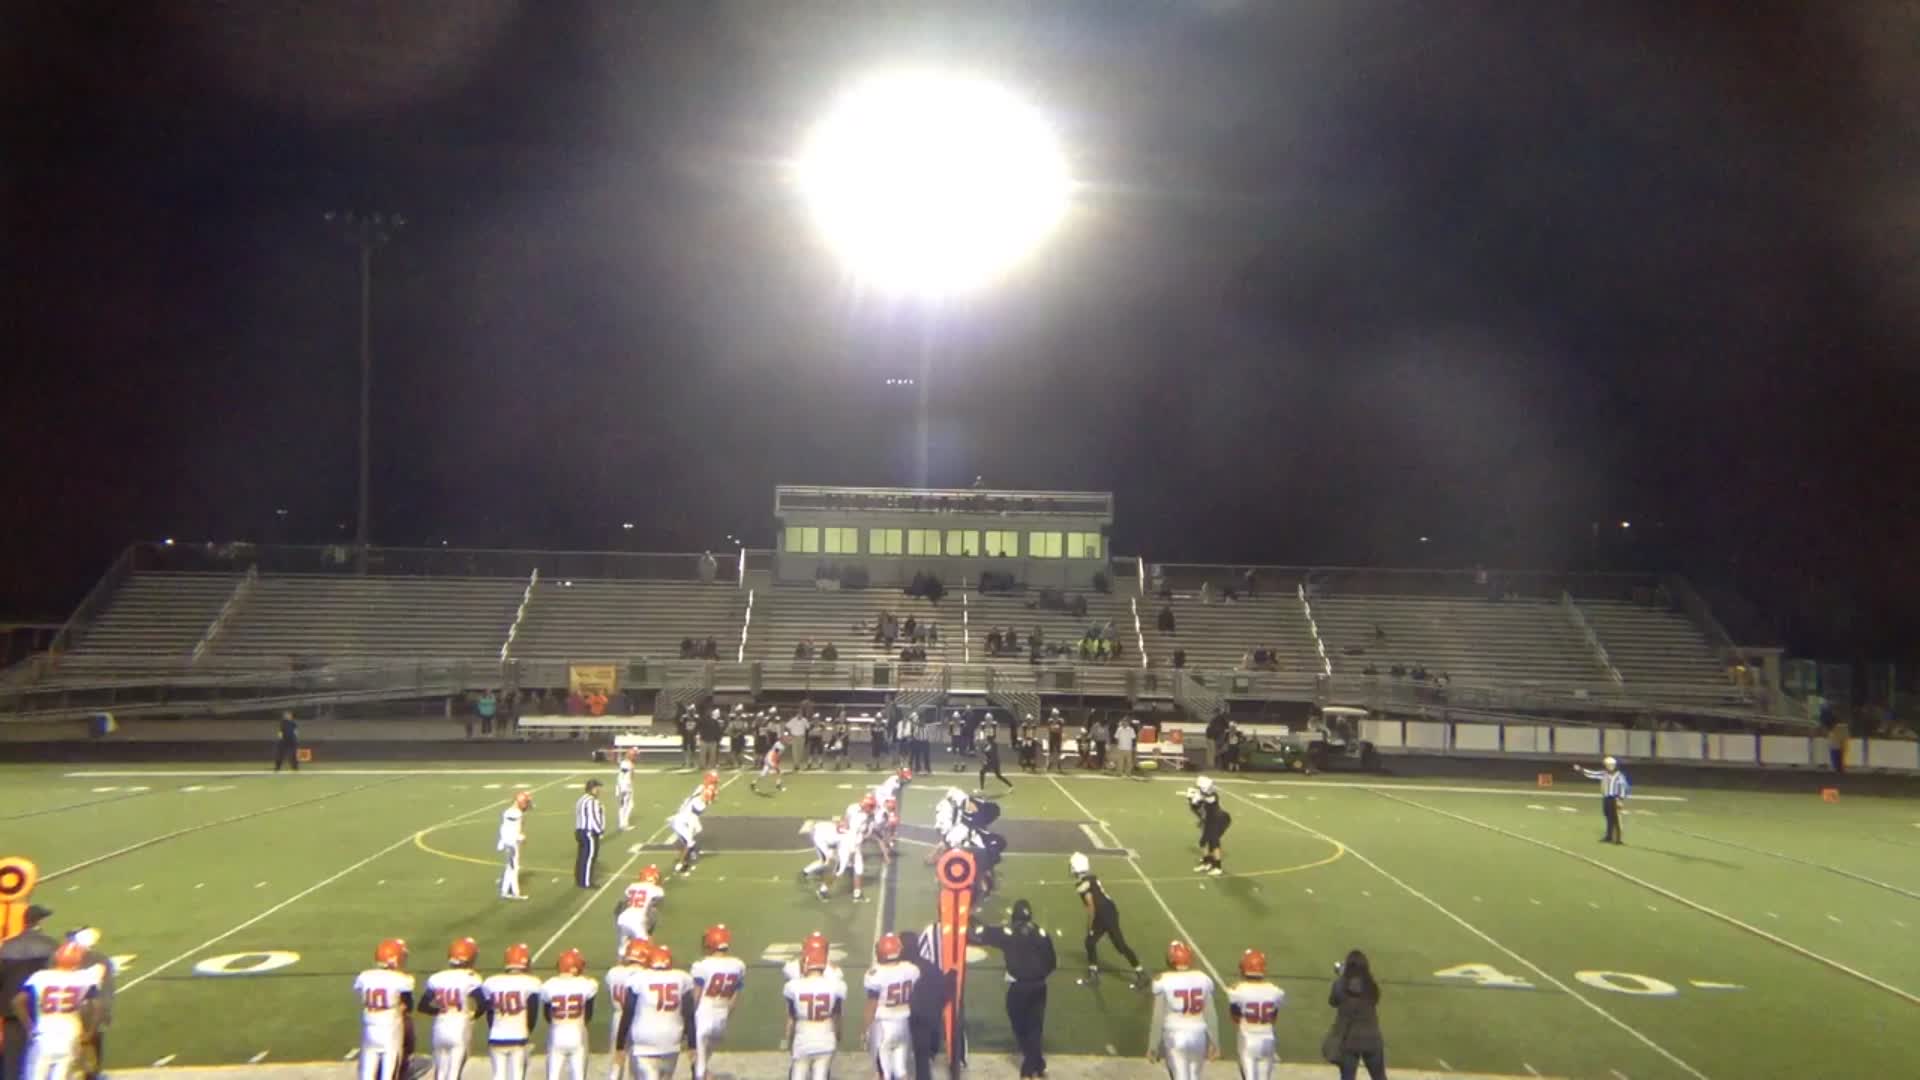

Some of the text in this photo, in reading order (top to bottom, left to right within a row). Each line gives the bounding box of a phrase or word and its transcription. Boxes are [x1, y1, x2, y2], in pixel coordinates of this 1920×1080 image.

[40, 985, 83, 1014] 63
[364, 987, 390, 1011] 10
[491, 990, 524, 1016] 40
[649, 983, 680, 1012] 75
[799, 992, 830, 1021] 72
[1173, 988, 1204, 1015] 76
